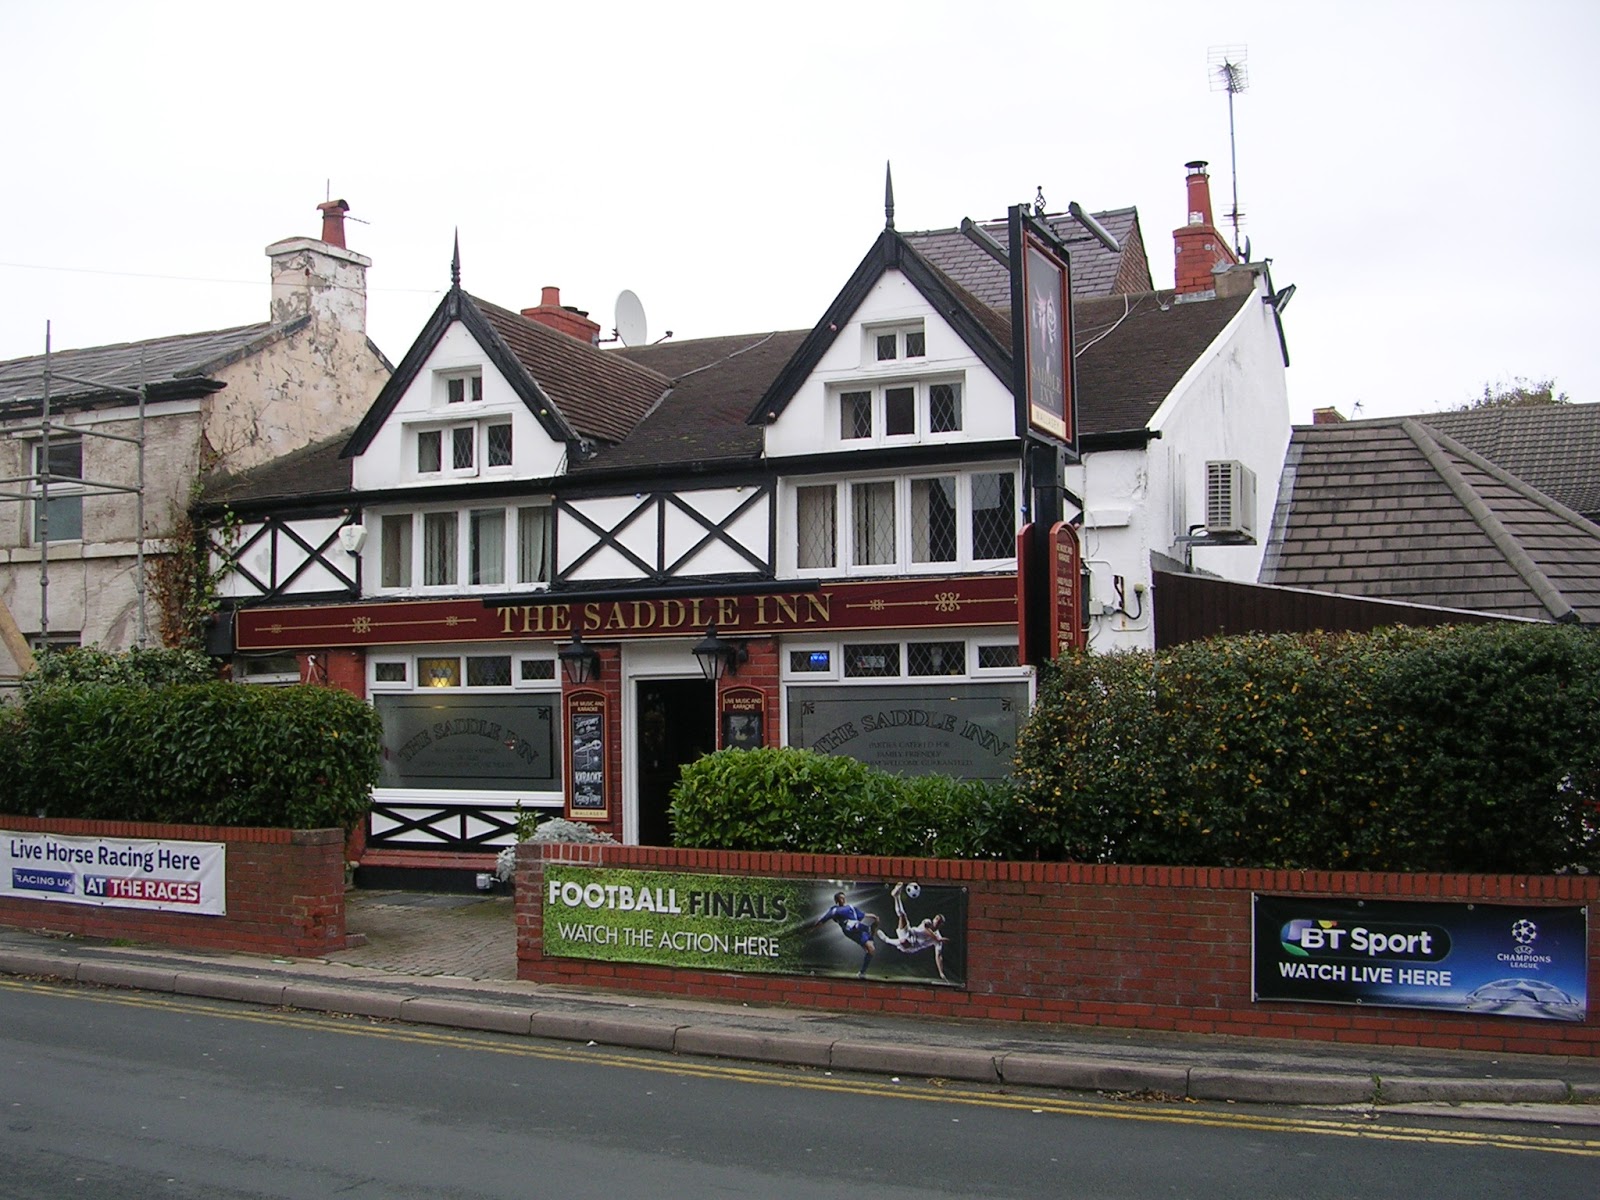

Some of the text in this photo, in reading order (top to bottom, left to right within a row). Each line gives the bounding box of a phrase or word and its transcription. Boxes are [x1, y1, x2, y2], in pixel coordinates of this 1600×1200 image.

[497, 593, 833, 633] THE SADDLE INN
[398, 729, 432, 762] THE
[433, 718, 502, 741] SADDLE
[812, 709, 1011, 757] THE SADDLE INN
[10, 839, 201, 872] Live Horse Racing Here
[15, 874, 73, 888] RACING UK
[86, 877, 199, 901] AT THE RACES
[549, 880, 789, 922] FOOTBALL FINALS
[558, 922, 780, 957] WATCH THE ACTION HERE
[1300, 927, 1432, 955] BT Sport
[1278, 962, 1452, 987] WATCH LIVE HERE
[1497, 953, 1552, 963] CHAMPIONS
